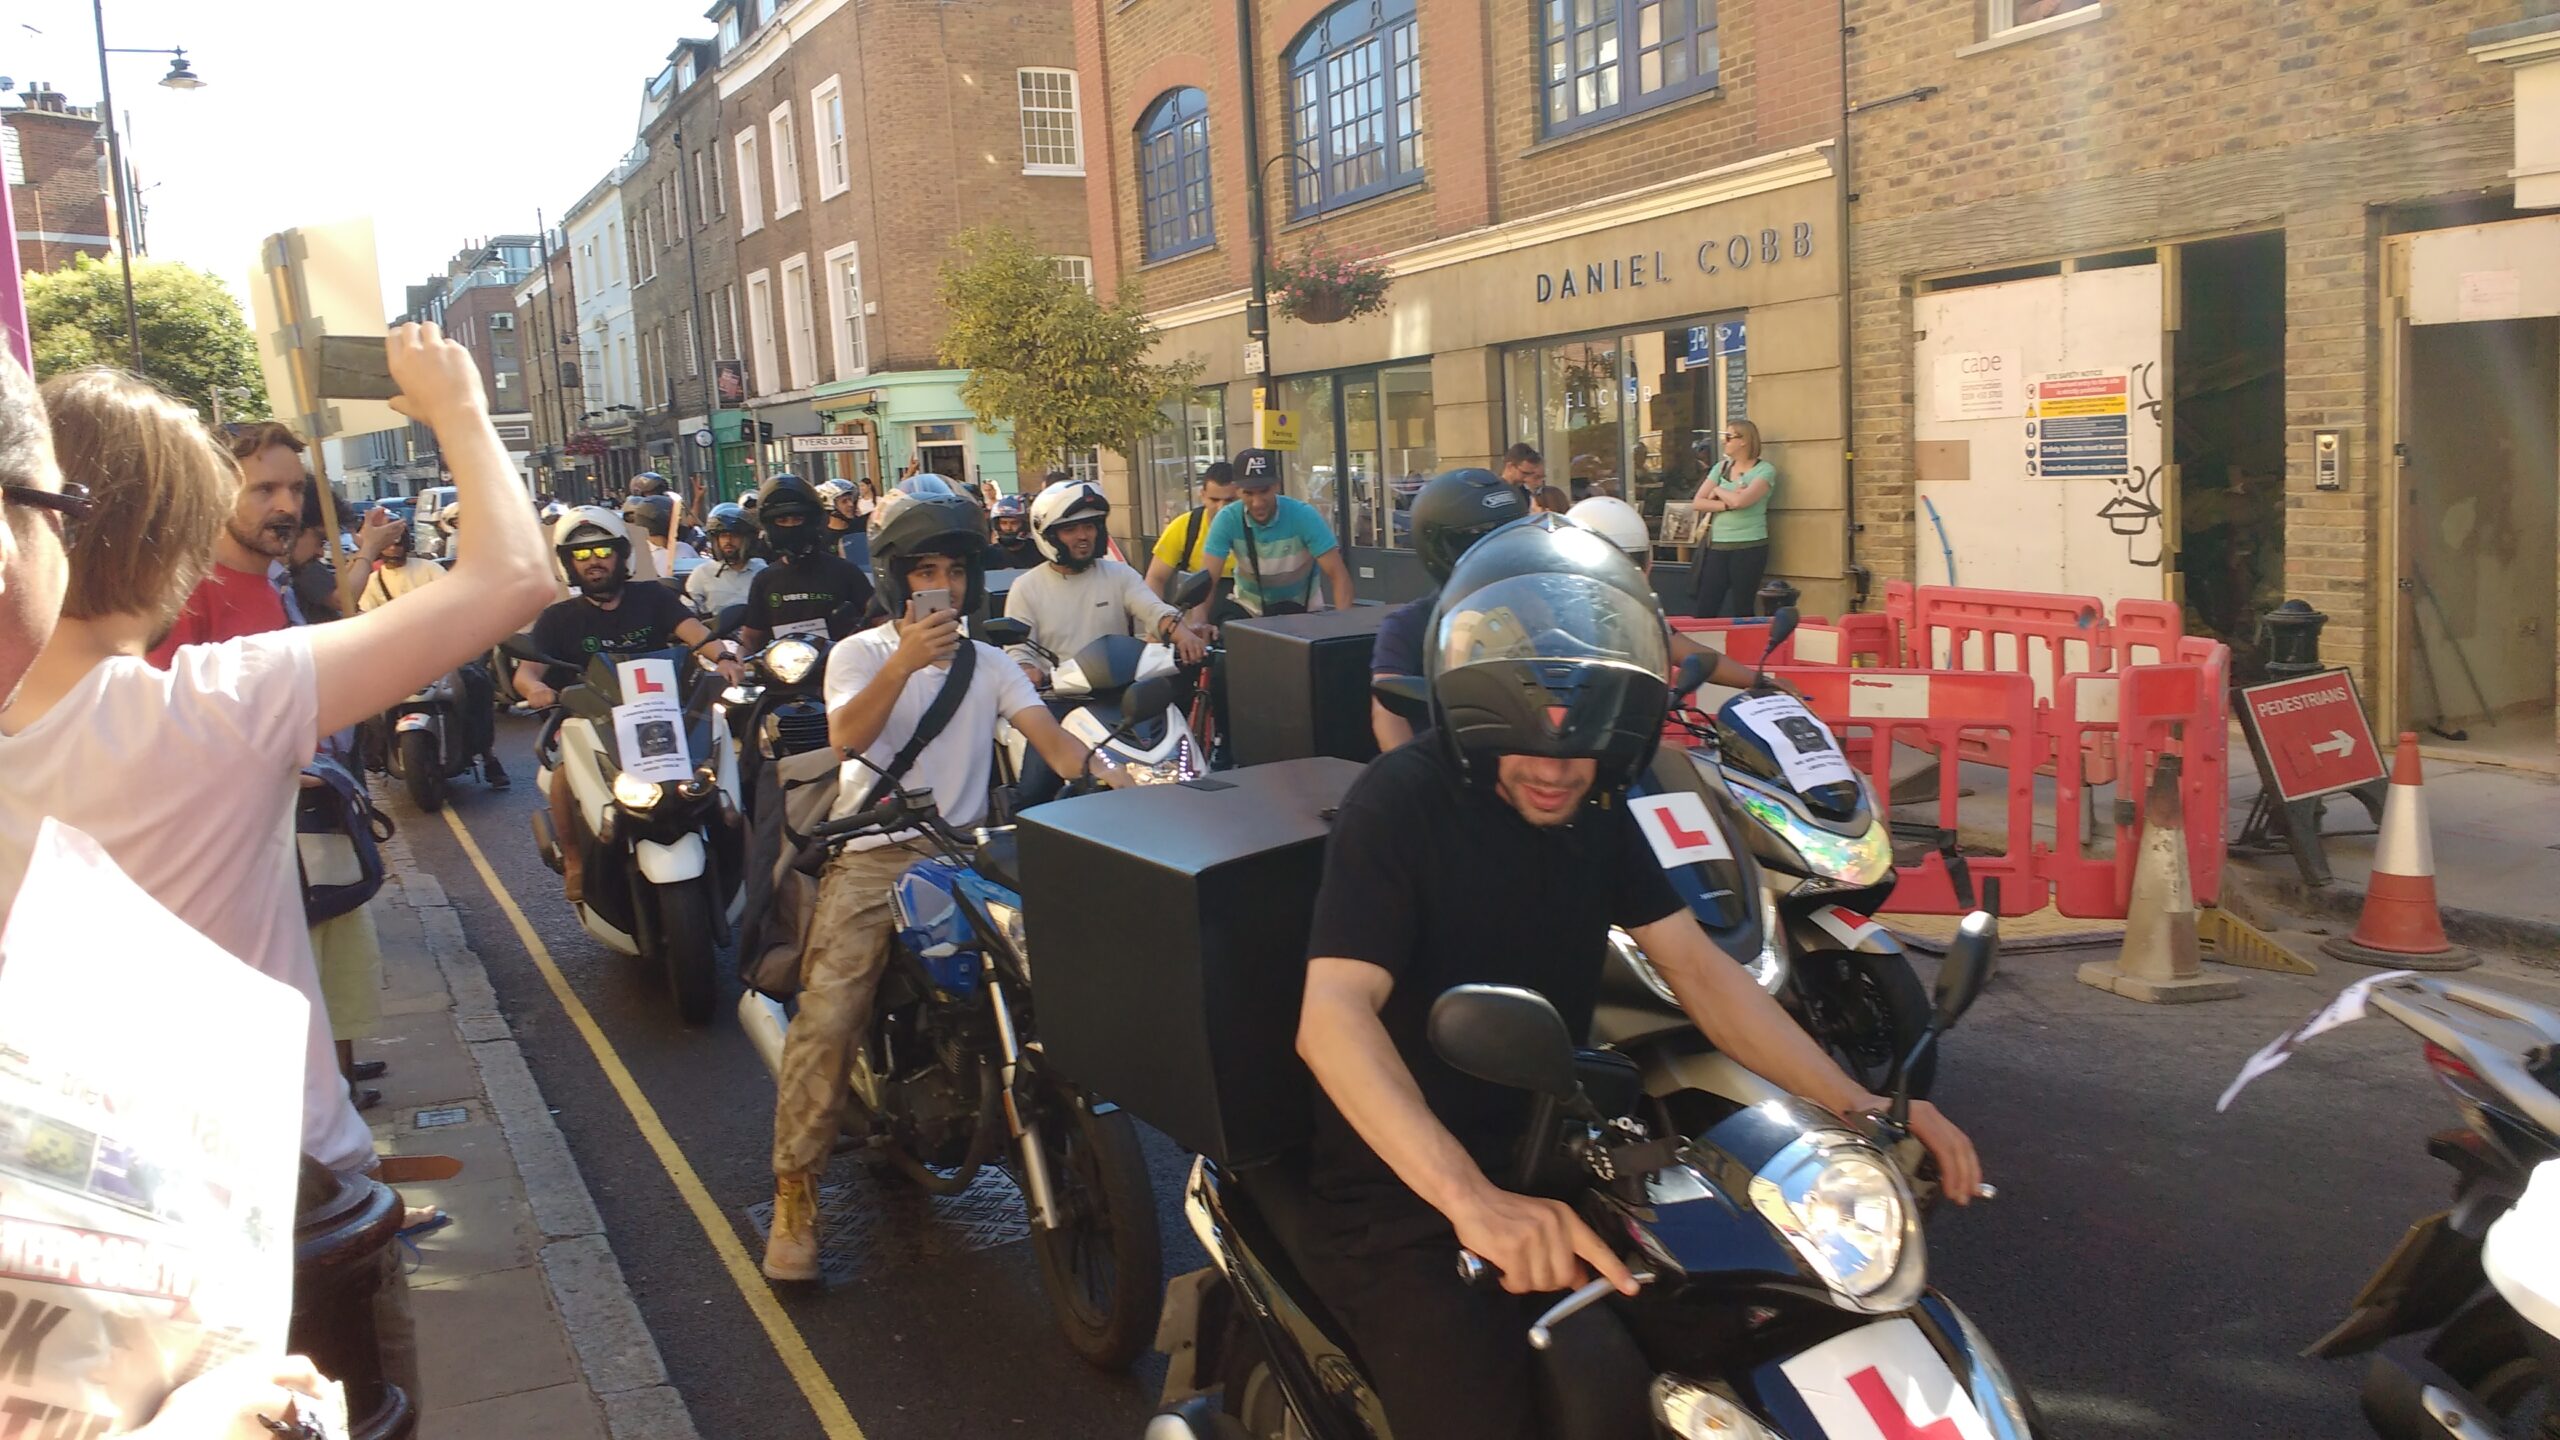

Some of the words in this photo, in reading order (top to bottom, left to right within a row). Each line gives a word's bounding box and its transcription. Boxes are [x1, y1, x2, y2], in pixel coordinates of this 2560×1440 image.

[1536, 250, 1672, 303] DANIEL
[1697, 221, 1813, 275] COBB
[1961, 355, 2002, 379] cape
[798, 438, 829, 447] TYERS
[830, 437, 857, 446] GATE
[633, 667, 665, 694] L
[2257, 686, 2349, 717] PEDESTRIANS
[1654, 807, 1712, 850] L
[1844, 1365, 1966, 1440] L
